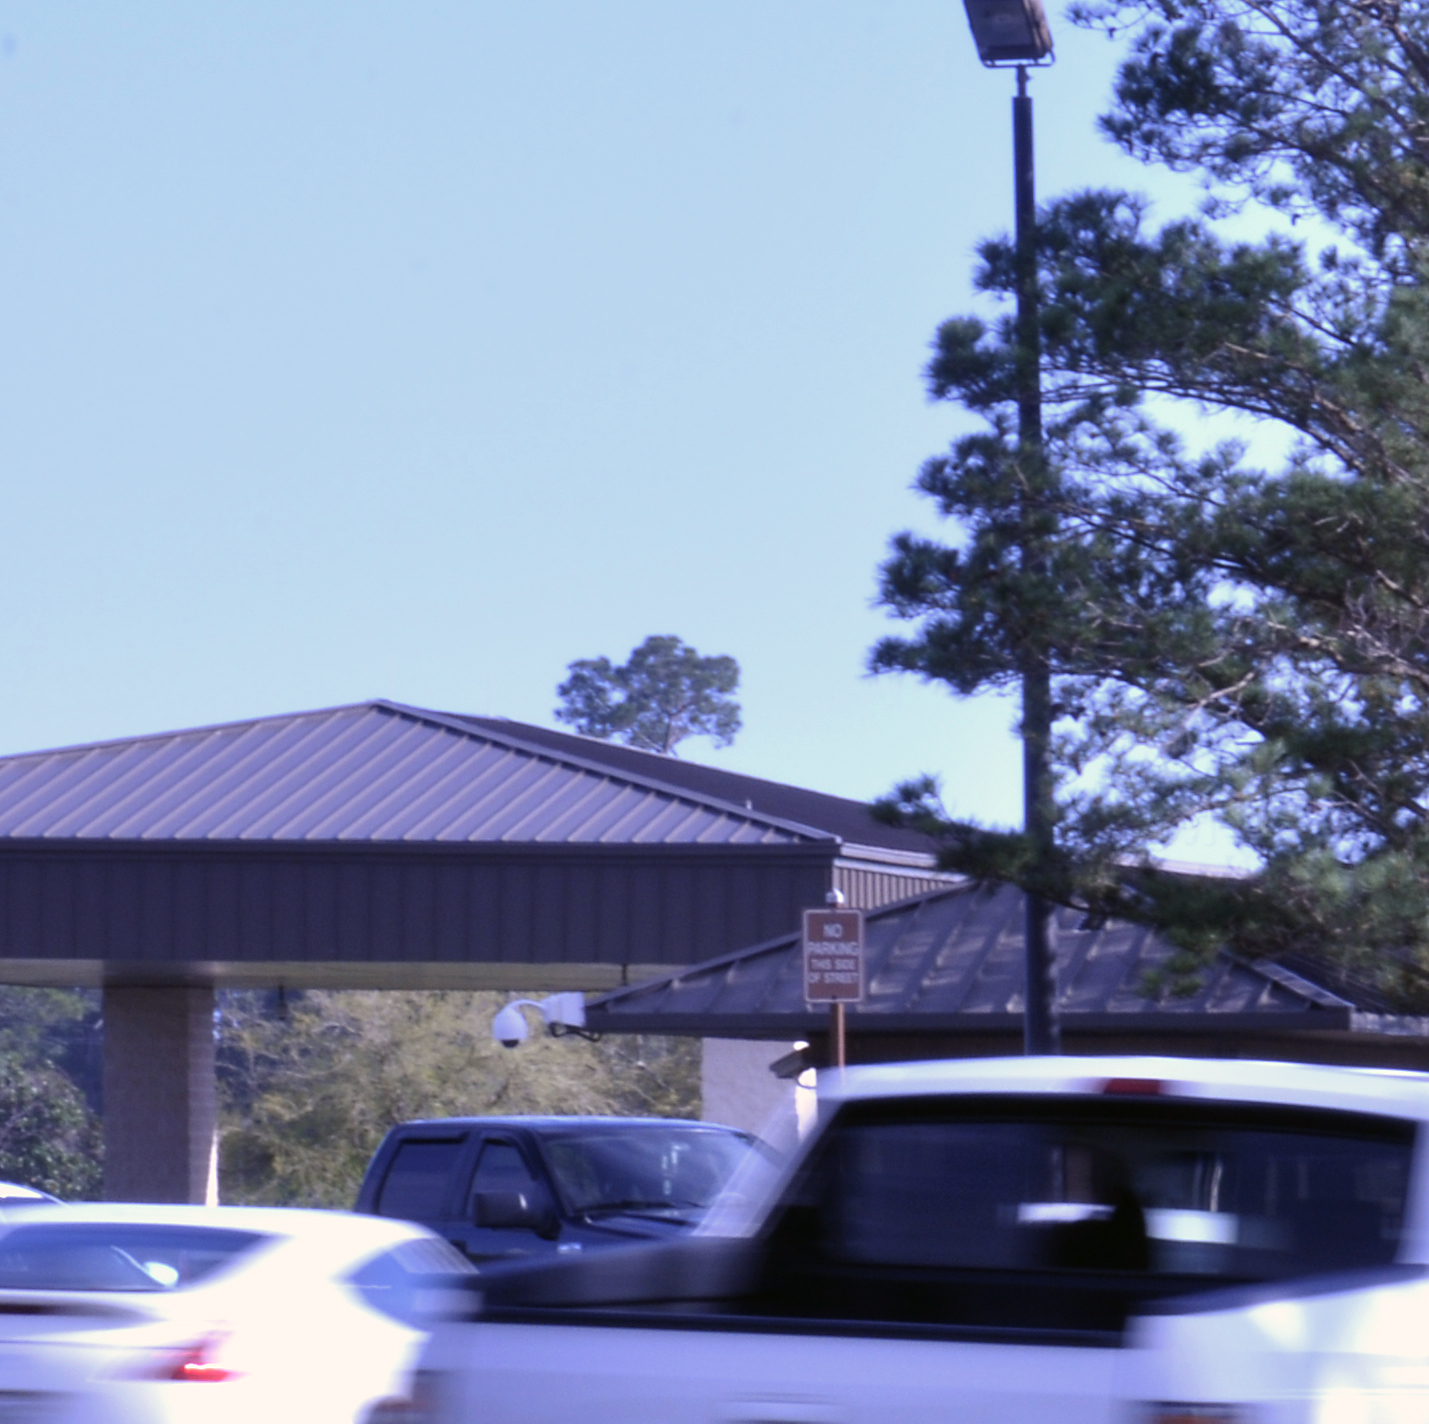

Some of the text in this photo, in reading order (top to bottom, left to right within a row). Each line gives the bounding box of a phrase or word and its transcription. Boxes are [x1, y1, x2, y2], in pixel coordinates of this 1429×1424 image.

[823, 924, 842, 938] NO
[807, 942, 859, 955] PARKING
[811, 959, 856, 970] THIS SIDE
[808, 972, 858, 984] OF STREET
